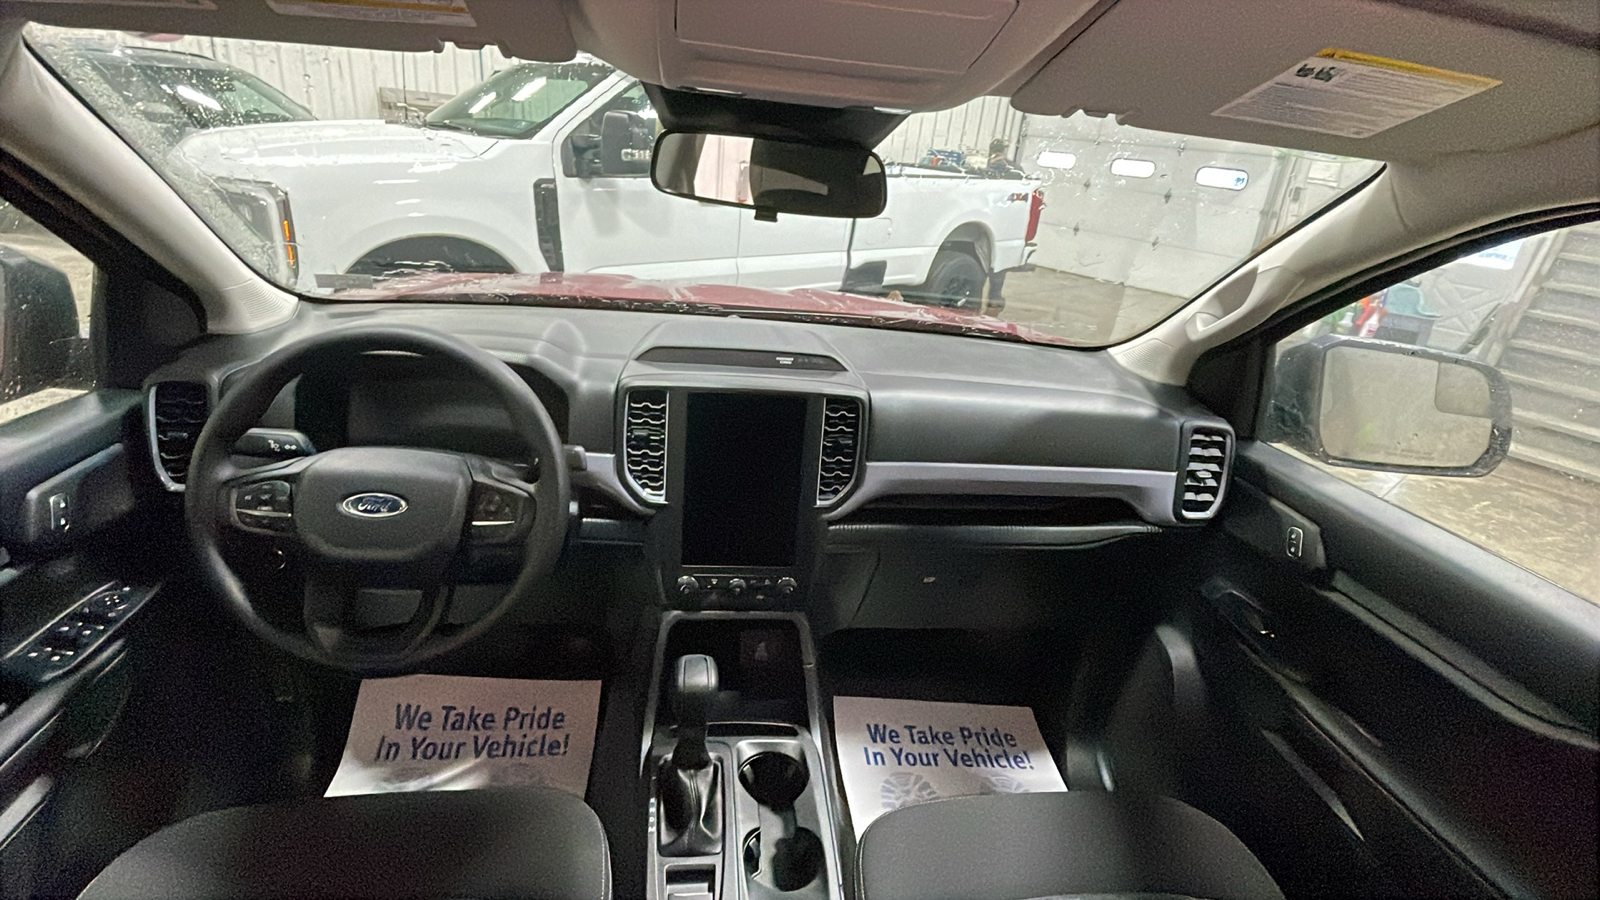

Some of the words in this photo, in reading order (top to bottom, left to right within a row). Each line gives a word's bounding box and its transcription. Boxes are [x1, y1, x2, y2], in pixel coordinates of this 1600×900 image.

[358, 496, 392, 512] Ford
[395, 703, 432, 731] We
[441, 705, 495, 731] Take
[503, 706, 566, 731] Pride
[374, 734, 400, 761] In
[410, 736, 466, 760] Your
[472, 733, 570, 759] Vehicle!
[866, 723, 901, 744] We
[904, 725, 954, 745] Take
[959, 726, 1017, 748] Pride
[863, 747, 886, 766] In
[890, 747, 939, 768] Your
[943, 748, 1035, 770] Vehicle!
